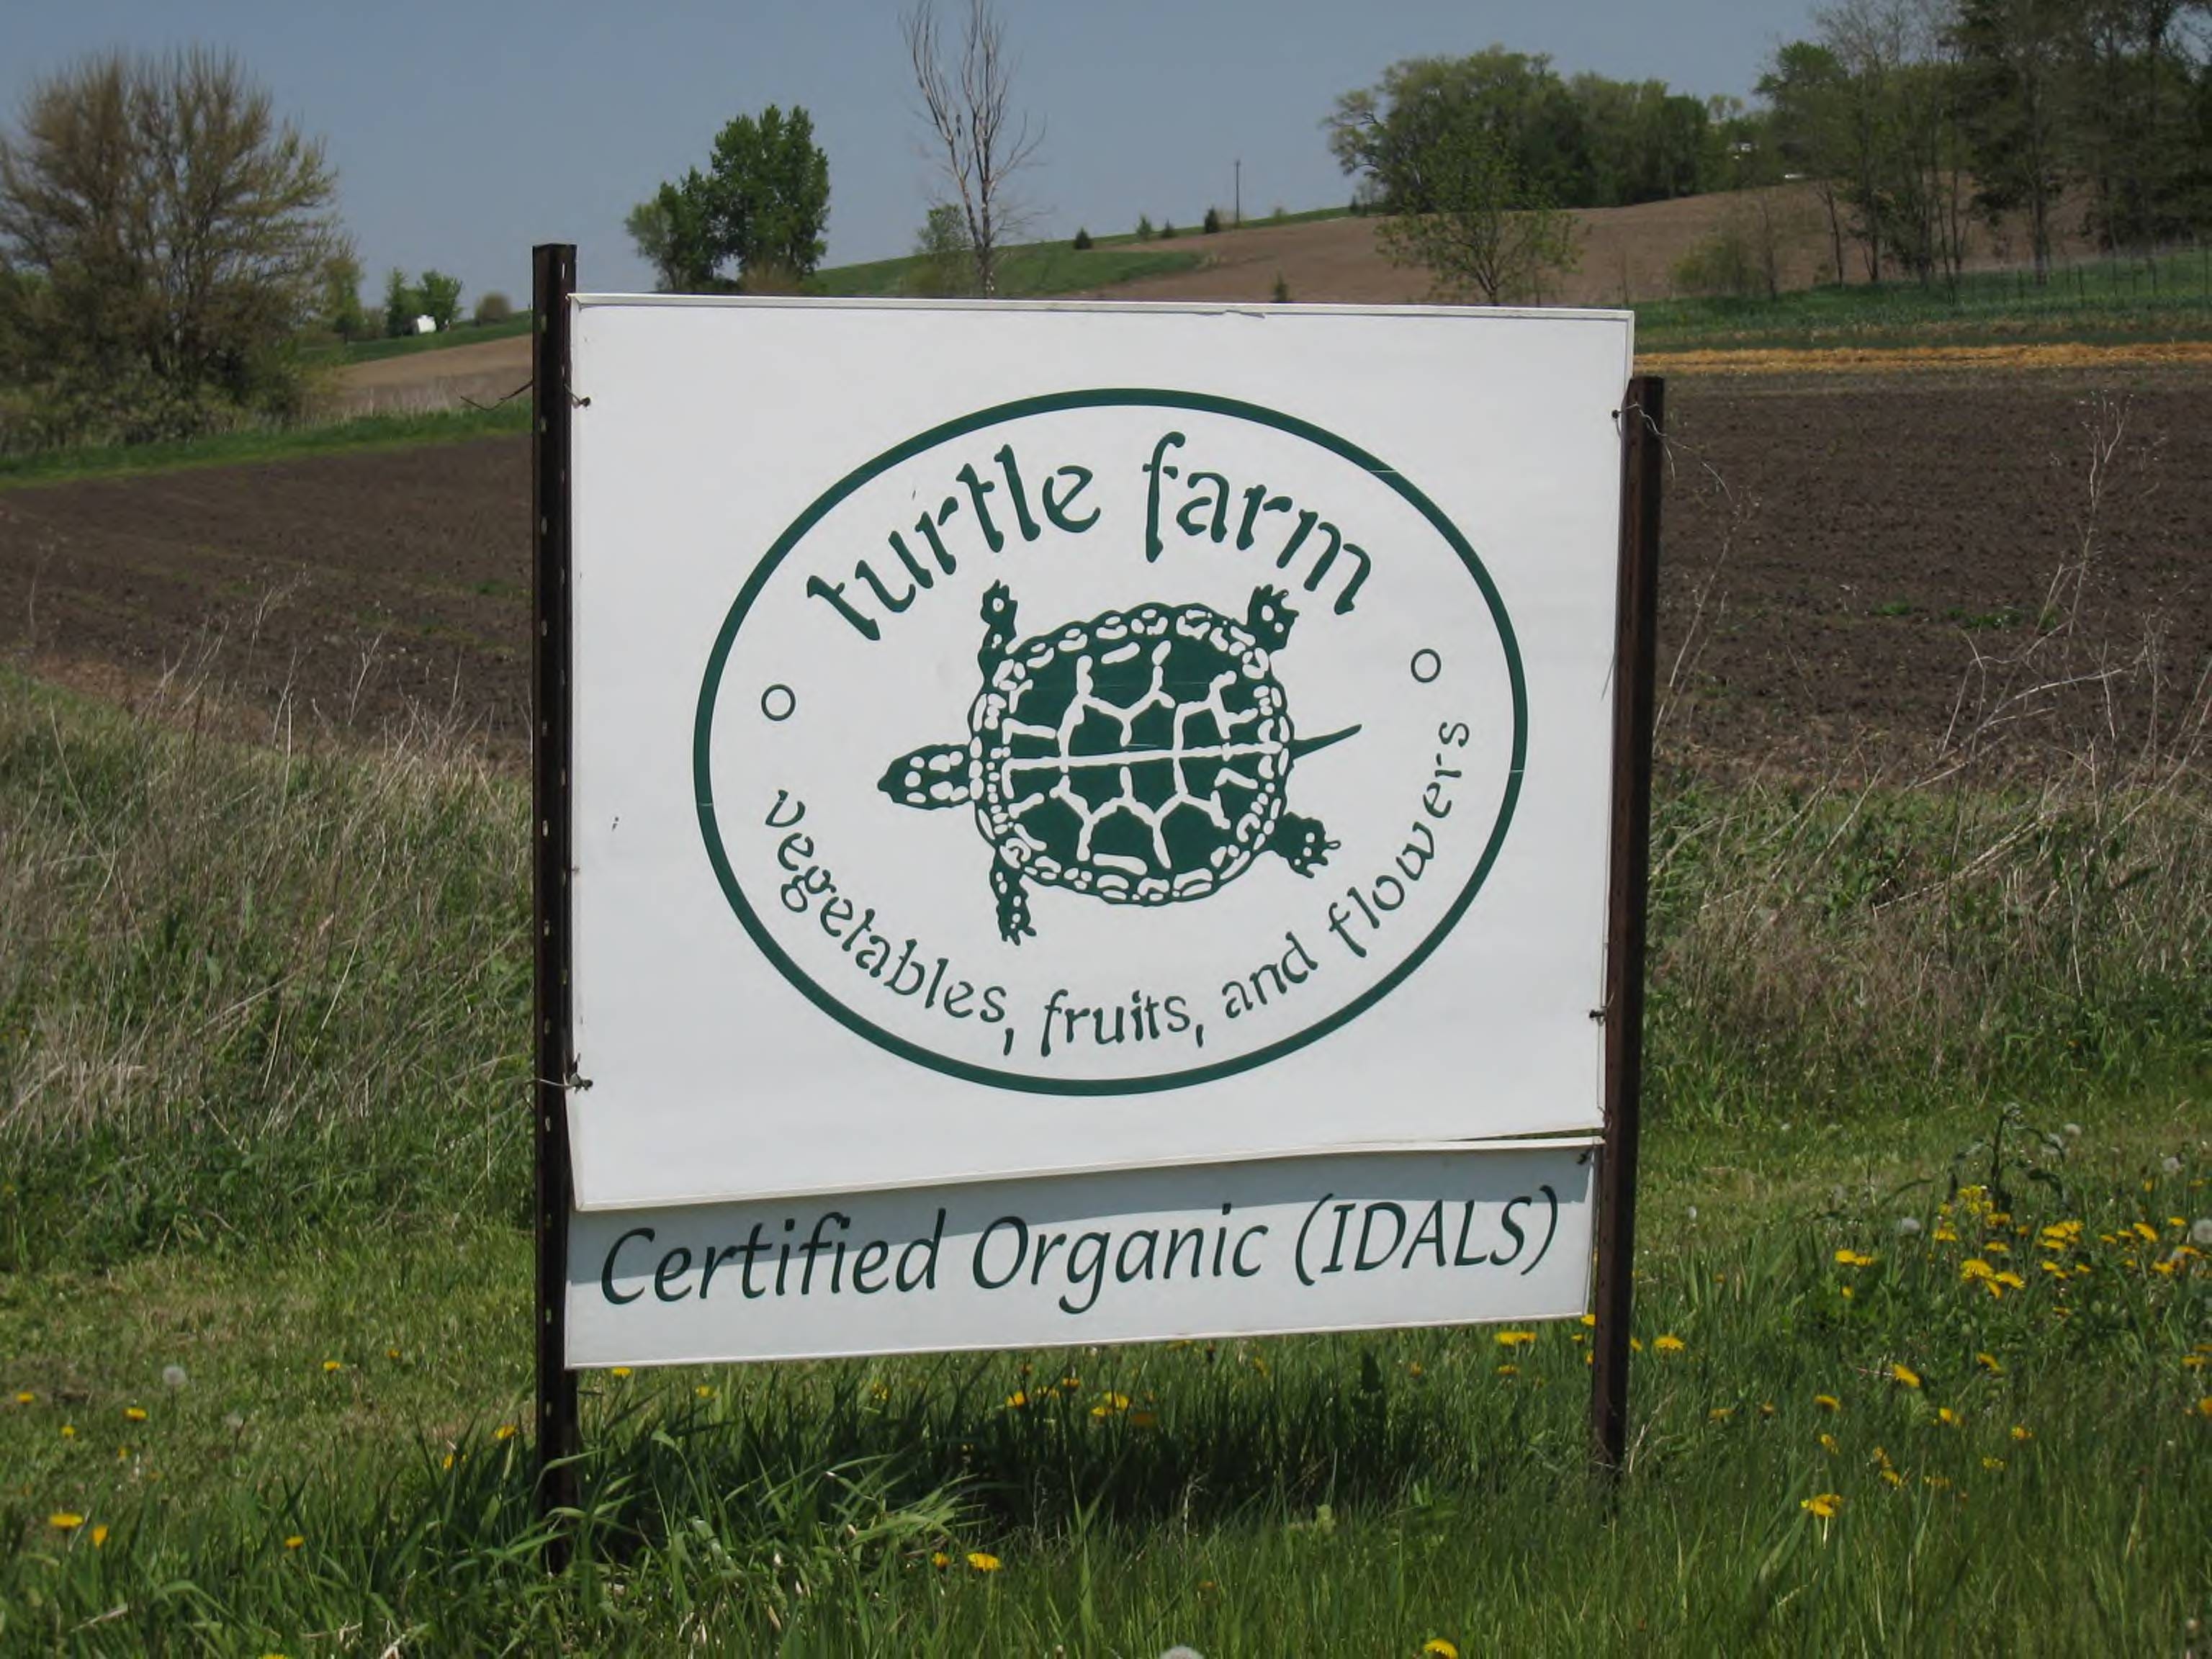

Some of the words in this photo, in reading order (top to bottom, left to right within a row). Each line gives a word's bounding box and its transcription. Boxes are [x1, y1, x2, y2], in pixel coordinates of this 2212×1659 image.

[806, 444, 1101, 641] turtle
[1142, 431, 1371, 616] farm
[765, 790, 1015, 1056] vegetables,
[1040, 989, 1204, 1057] fruits,
[1222, 932, 1318, 1019] and
[1328, 722, 1470, 958] flowers
[601, 1208, 947, 1305] Certified
[972, 1202, 1269, 1314] Organic
[1294, 1185, 1559, 1285] (IDALS)
